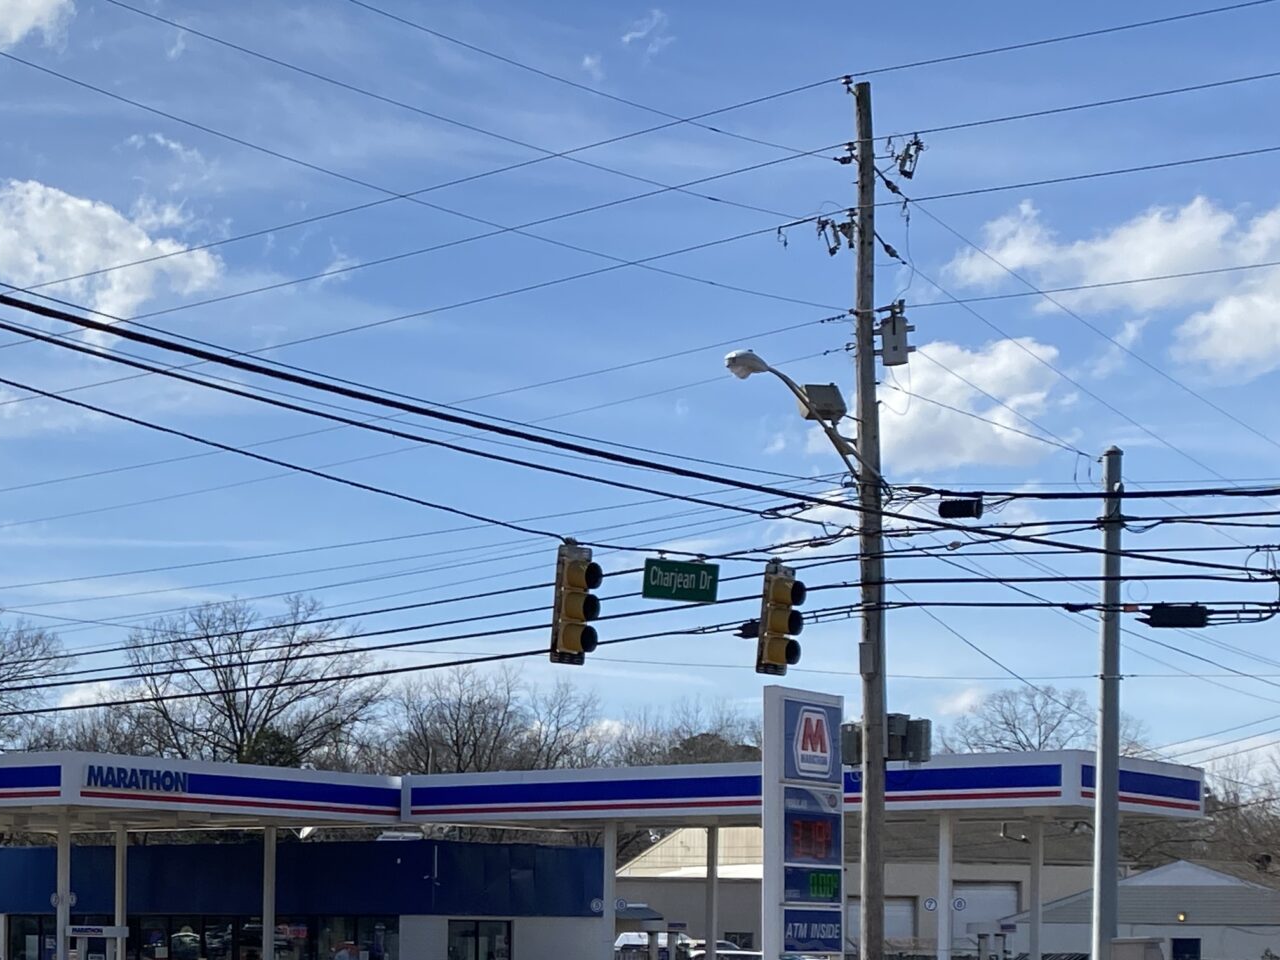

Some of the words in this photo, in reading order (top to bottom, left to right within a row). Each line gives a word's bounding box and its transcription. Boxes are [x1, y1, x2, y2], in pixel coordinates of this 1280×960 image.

[650, 566, 695, 594] Charjean
[699, 570, 713, 590] Dr
[86, 765, 189, 793] MARATHON
[785, 923, 808, 939] ATM
[810, 923, 841, 939] INSIDE
